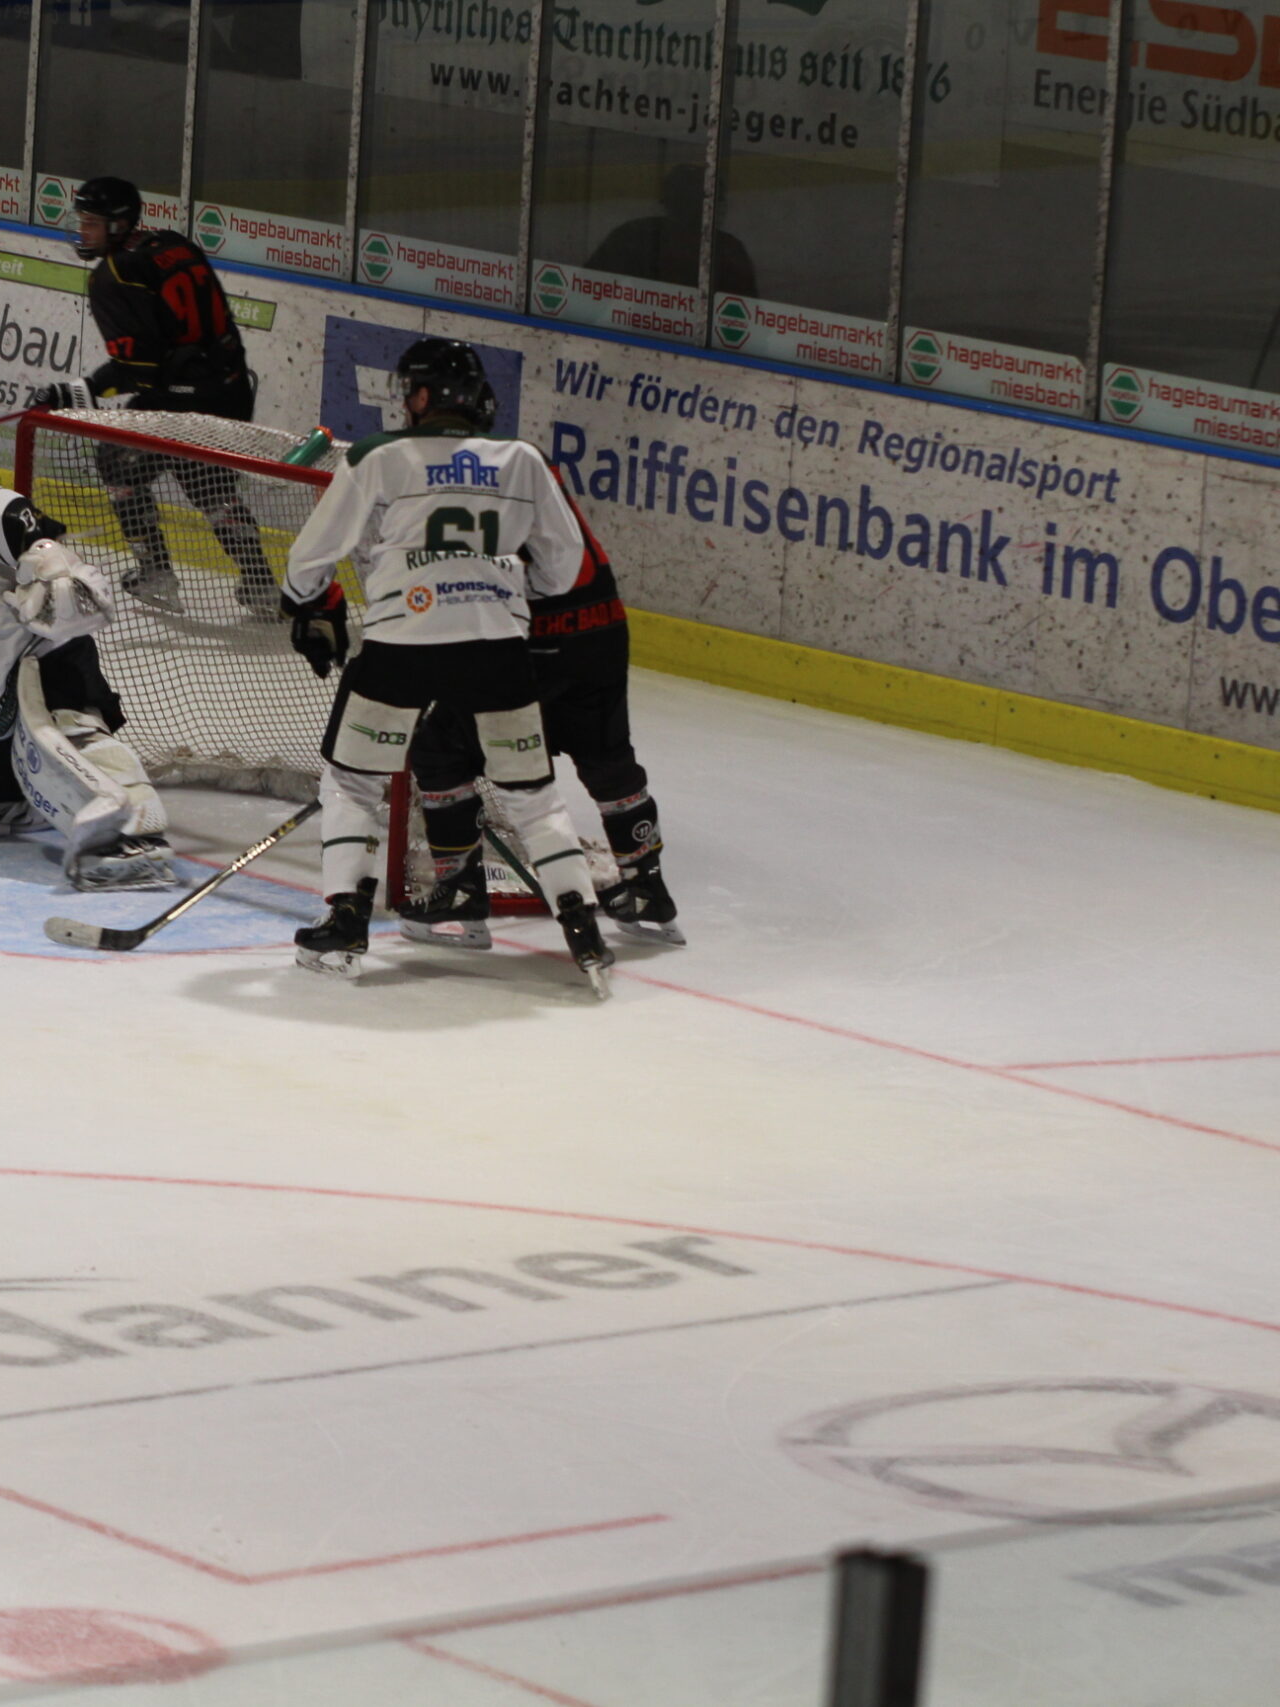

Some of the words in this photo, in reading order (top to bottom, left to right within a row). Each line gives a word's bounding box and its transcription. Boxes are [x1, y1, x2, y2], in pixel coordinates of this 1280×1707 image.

[552, 7, 787, 80] Trachtenaus
[799, 44, 864, 92] seit
[877, 54, 951, 103] 186
[430, 62, 859, 148] www.rachten-jeger.de
[1033, 68, 1168, 130] Enerie
[230, 213, 342, 249] hagebaumarkt
[266, 245, 341, 273] miesbach
[397, 241, 514, 281] hagebaumarkt
[435, 274, 513, 305] miesbach
[572, 273, 695, 313] hagebaumarkt
[612, 307, 693, 337] miesbach
[755, 305, 884, 348] hagebaumarkt
[796, 342, 882, 373] miesbach
[947, 340, 1083, 385] hagebaumarkt
[991, 377, 1081, 410] miesbach
[554, 356, 614, 401] Wir
[629, 372, 756, 432] fördern
[775, 405, 839, 448] den
[858, 420, 1120, 503] Regionalsport
[1193, 415, 1280, 448] miesbac
[425, 506, 500, 556] 61
[551, 421, 1012, 587] Raiffeisenbank
[1043, 522, 1118, 609] im
[1149, 545, 1280, 643] Obe
[533, 613, 571, 637] EHC
[377, 730, 407, 746] DCB
[516, 732, 542, 751] DCB
